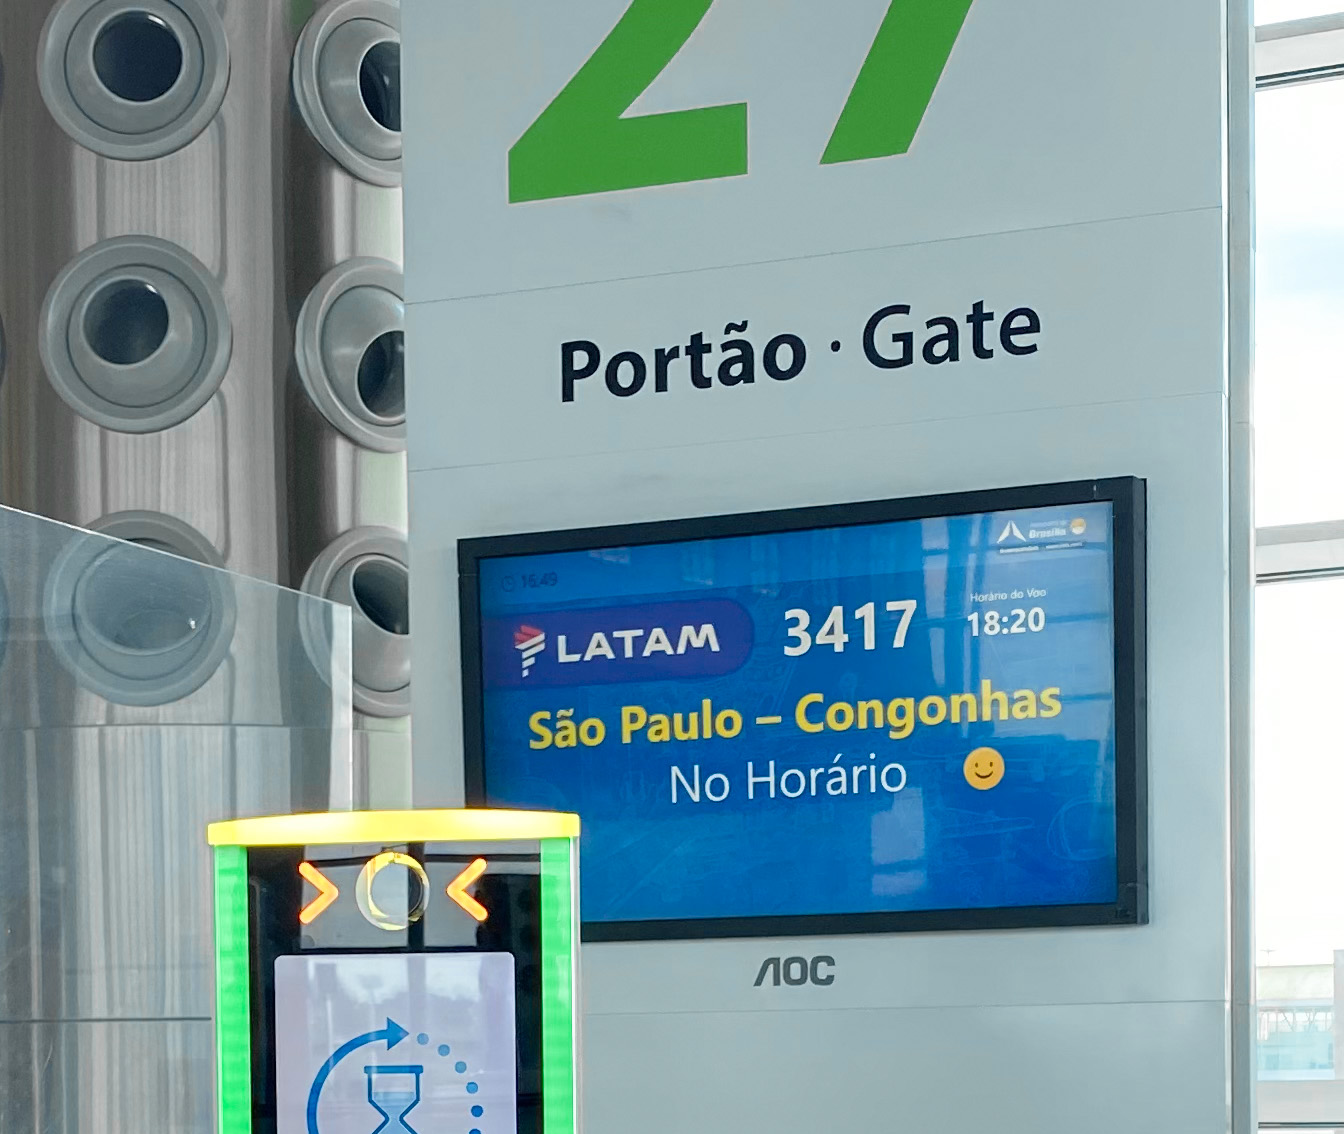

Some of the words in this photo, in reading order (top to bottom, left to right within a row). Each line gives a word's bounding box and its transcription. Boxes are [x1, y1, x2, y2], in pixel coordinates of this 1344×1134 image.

[560, 320, 807, 403] Portão
[862, 300, 1042, 371] Gate
[969, 590, 1008, 603] Horário
[1010, 589, 1024, 599] do
[1026, 587, 1047, 598] Voo
[556, 623, 720, 663] LATAM
[783, 600, 918, 658] 3417
[967, 607, 1046, 637] 18:20
[528, 708, 606, 751] São
[621, 699, 743, 744] Paulo
[794, 679, 1062, 740] Congonhas
[670, 764, 731, 804] No
[747, 753, 907, 801] Horário
[752, 955, 836, 987] AOC
